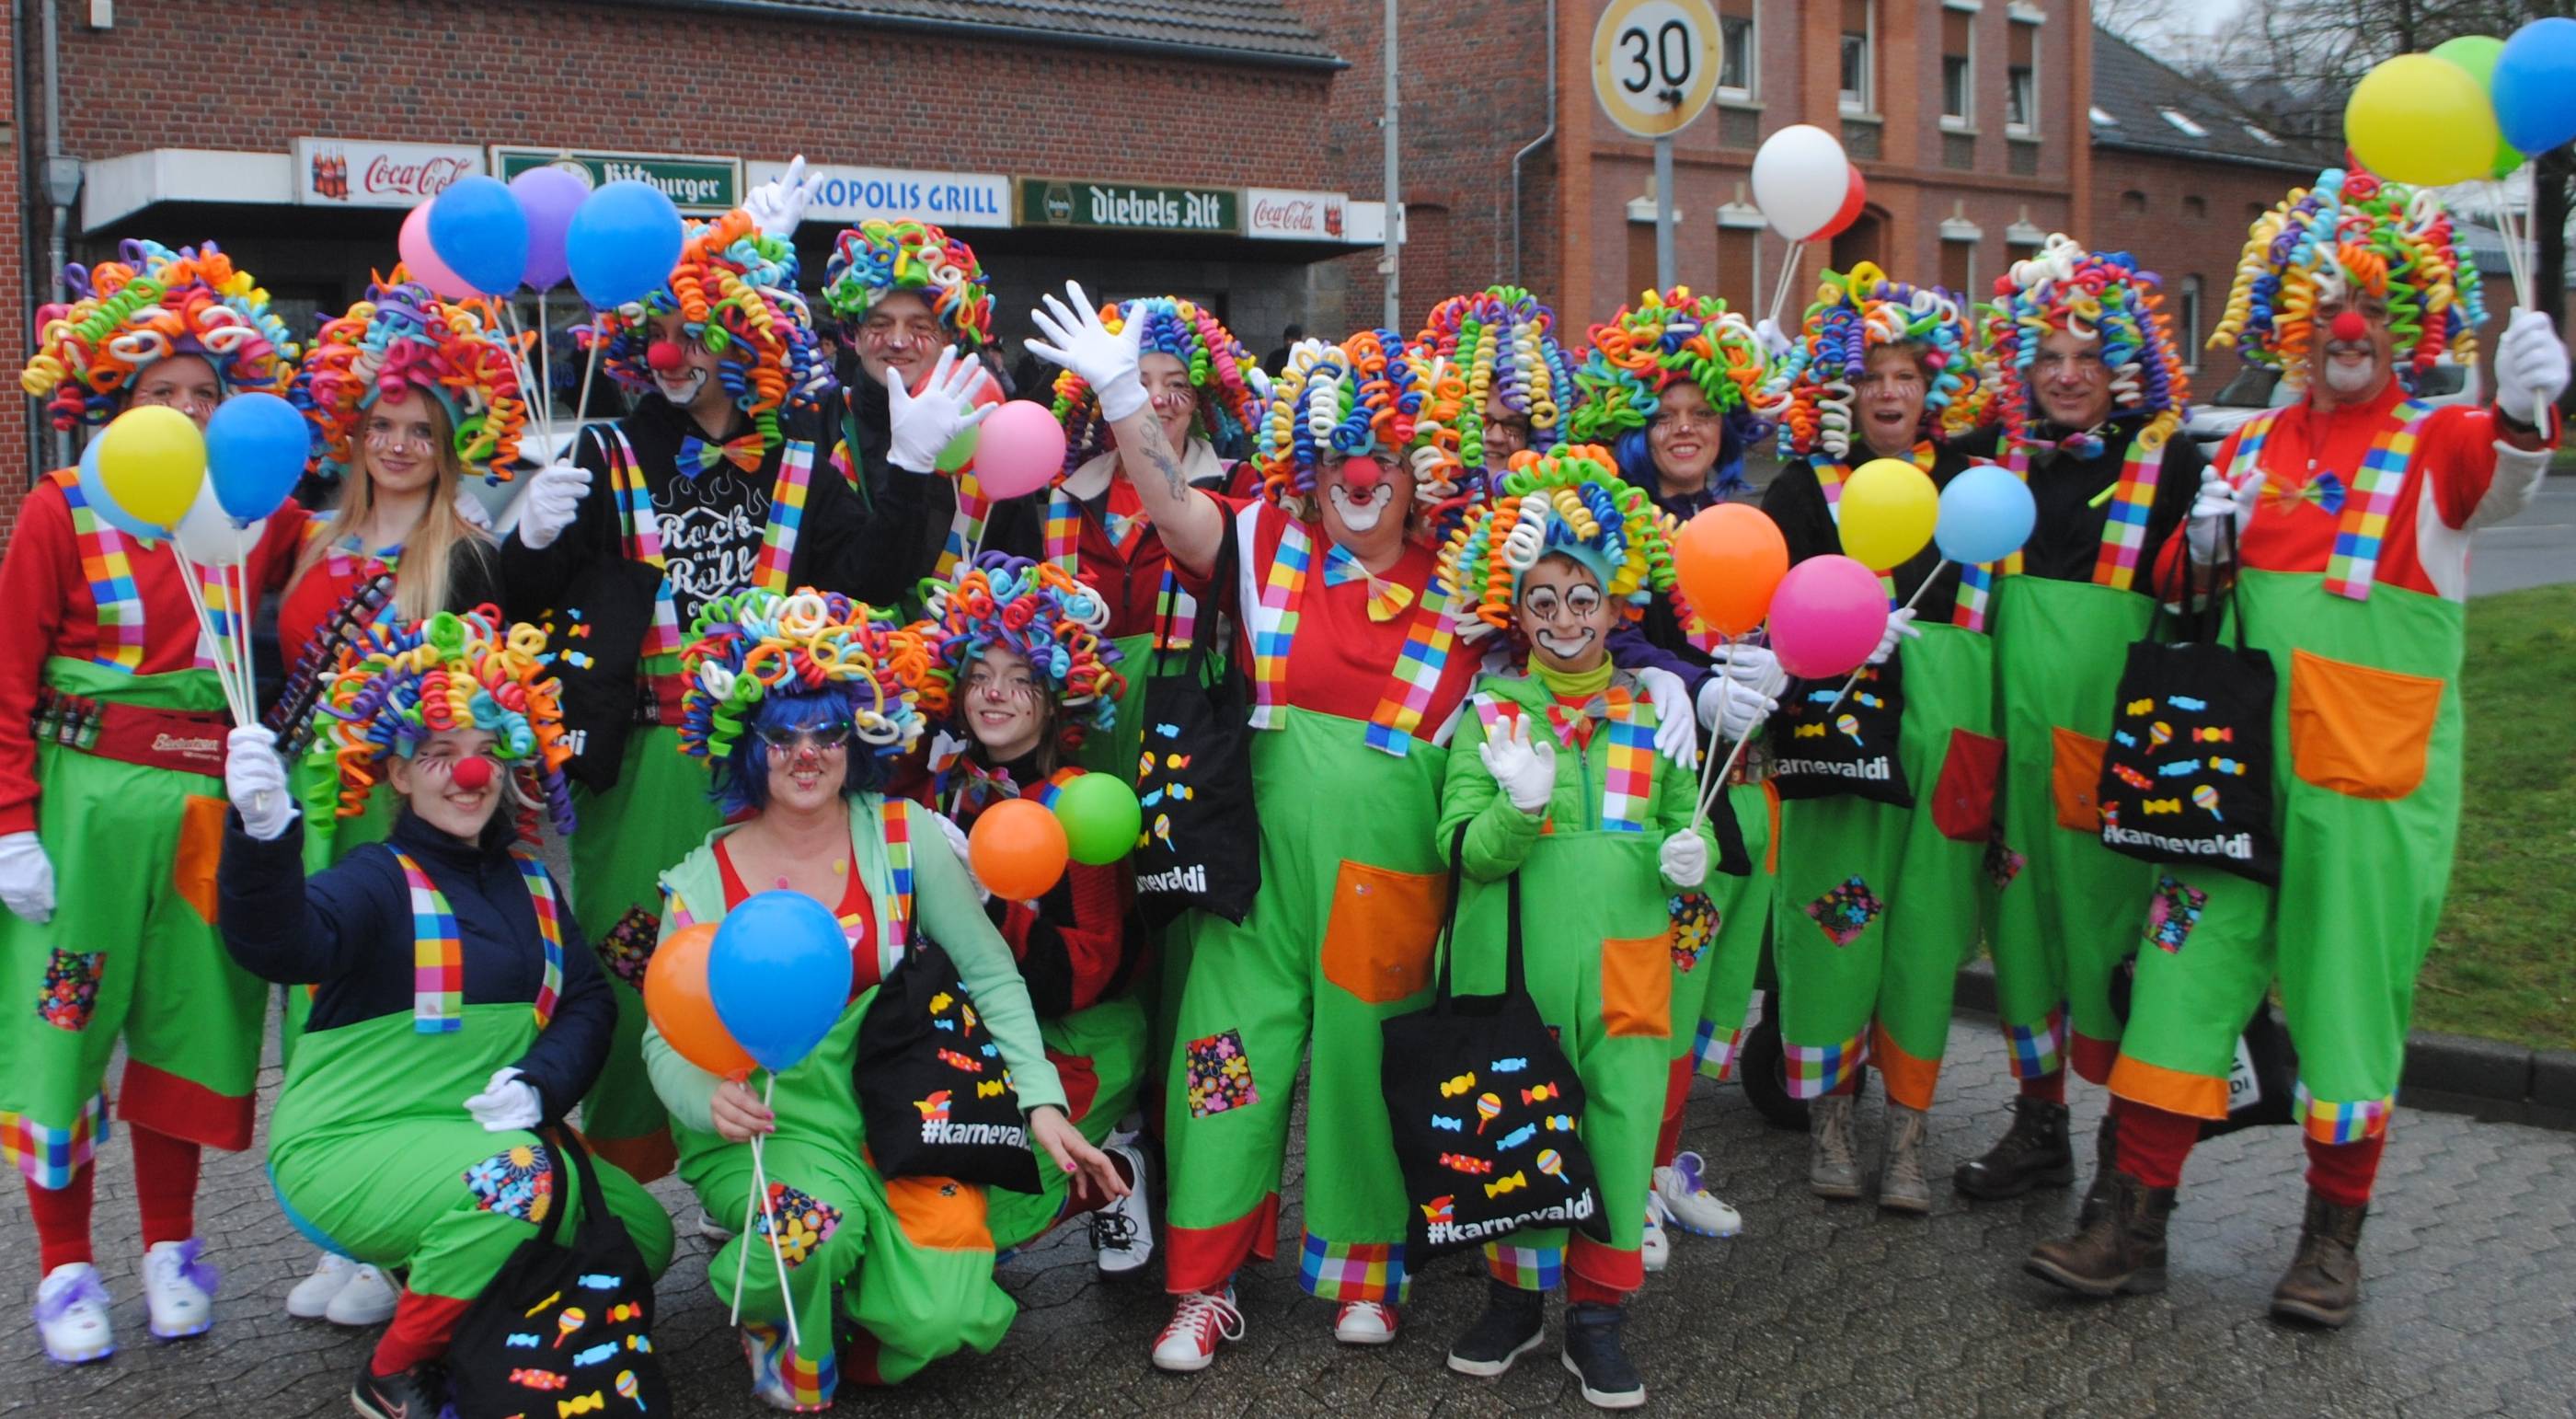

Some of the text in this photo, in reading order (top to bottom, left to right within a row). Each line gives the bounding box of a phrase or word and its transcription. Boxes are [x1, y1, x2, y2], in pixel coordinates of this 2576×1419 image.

[1620, 18, 1691, 93] 30
[364, 154, 473, 195] Coca-Col
[771, 176, 998, 214] OPOLIS GRILL
[1089, 185, 1221, 229] Diebels Alt
[1253, 197, 1316, 231] Coca-Cola
[656, 503, 753, 550] Rock
[665, 545, 756, 596] Roll
[693, 544, 722, 561] and
[1774, 755, 1891, 780] arnevaldi
[1135, 863, 1207, 894] nevaldi
[921, 1117, 1031, 1151] #karneval
